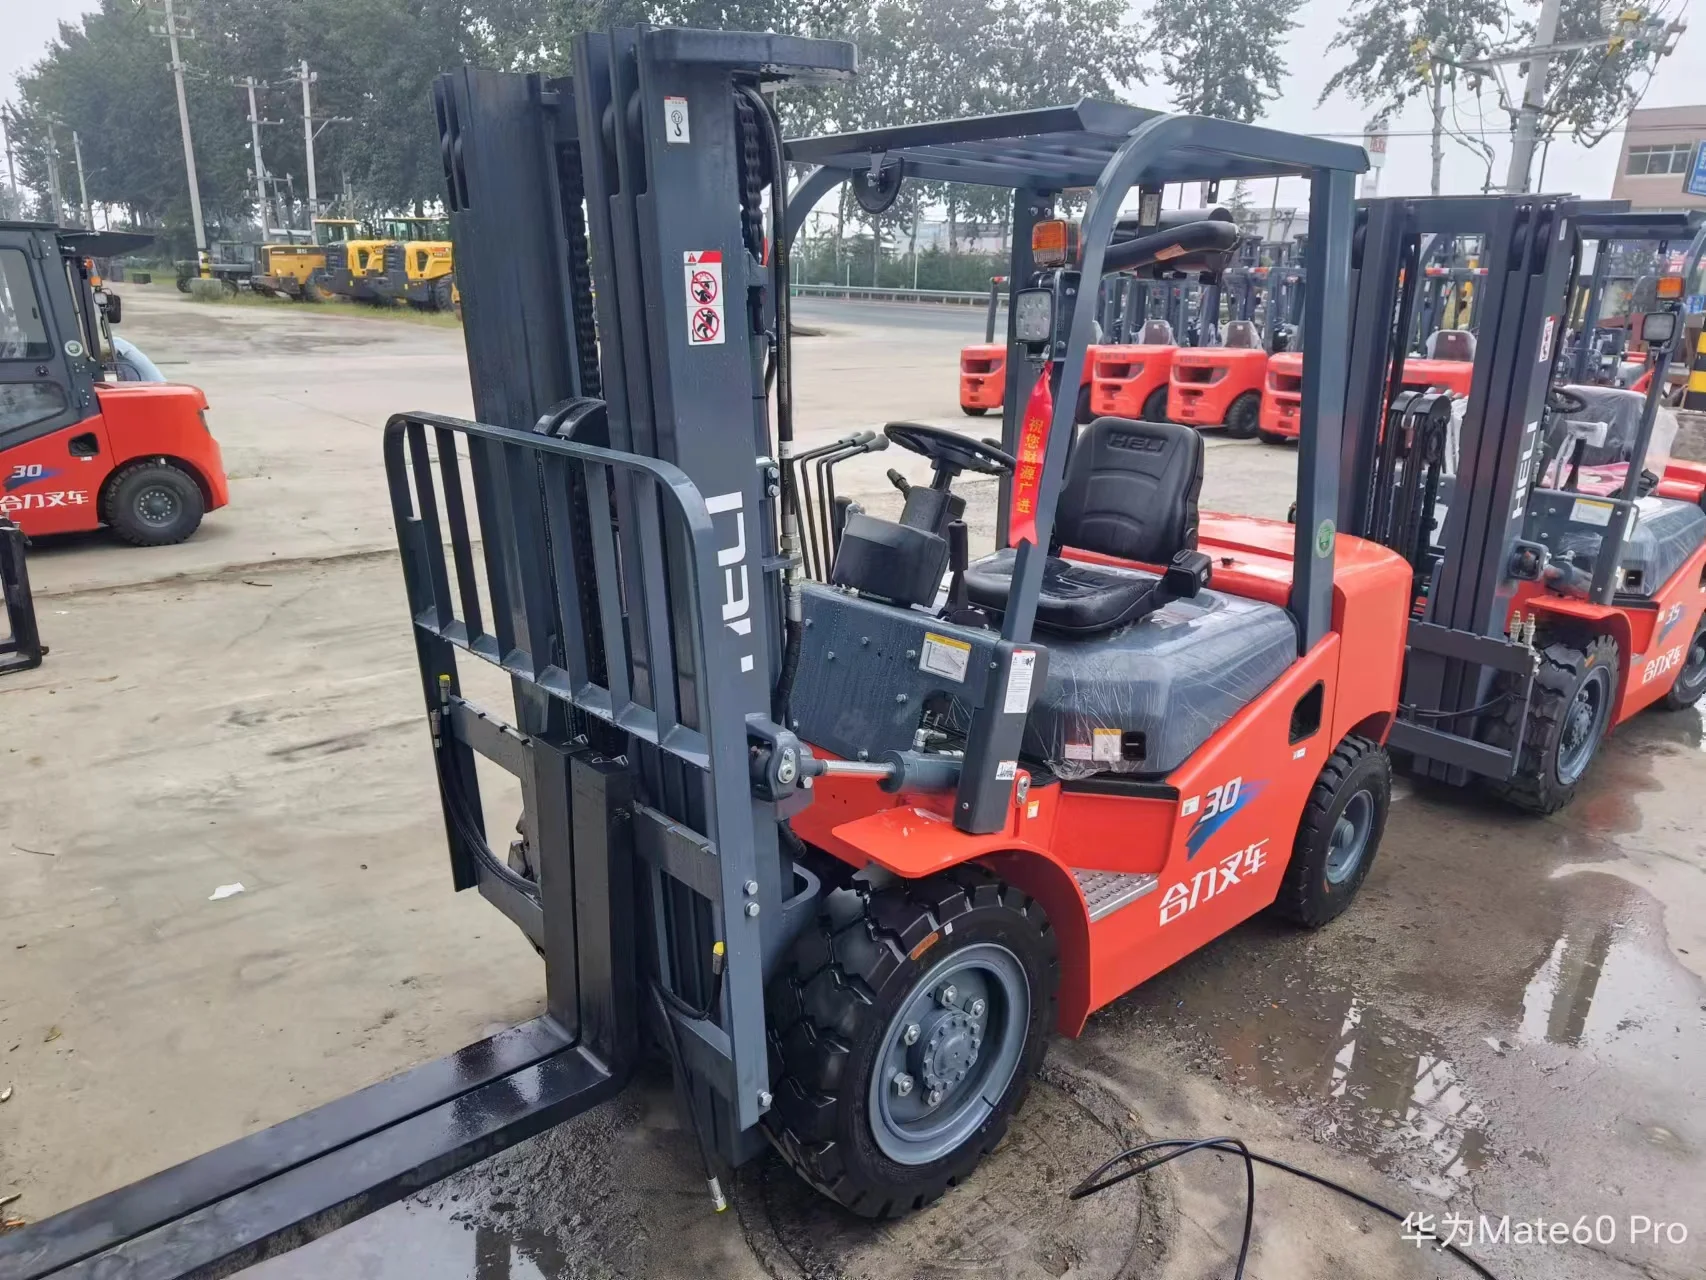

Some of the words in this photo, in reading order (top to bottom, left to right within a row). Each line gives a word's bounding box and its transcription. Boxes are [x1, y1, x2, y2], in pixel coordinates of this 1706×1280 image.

[11, 464, 42, 478] 30
[1512, 421, 1538, 519] HELI
[0, 490, 89, 512] 合力叉车
[1642, 644, 1685, 684] 合力叉车
[1199, 776, 1242, 822] 30
[1158, 838, 1270, 927] 合力叉车
